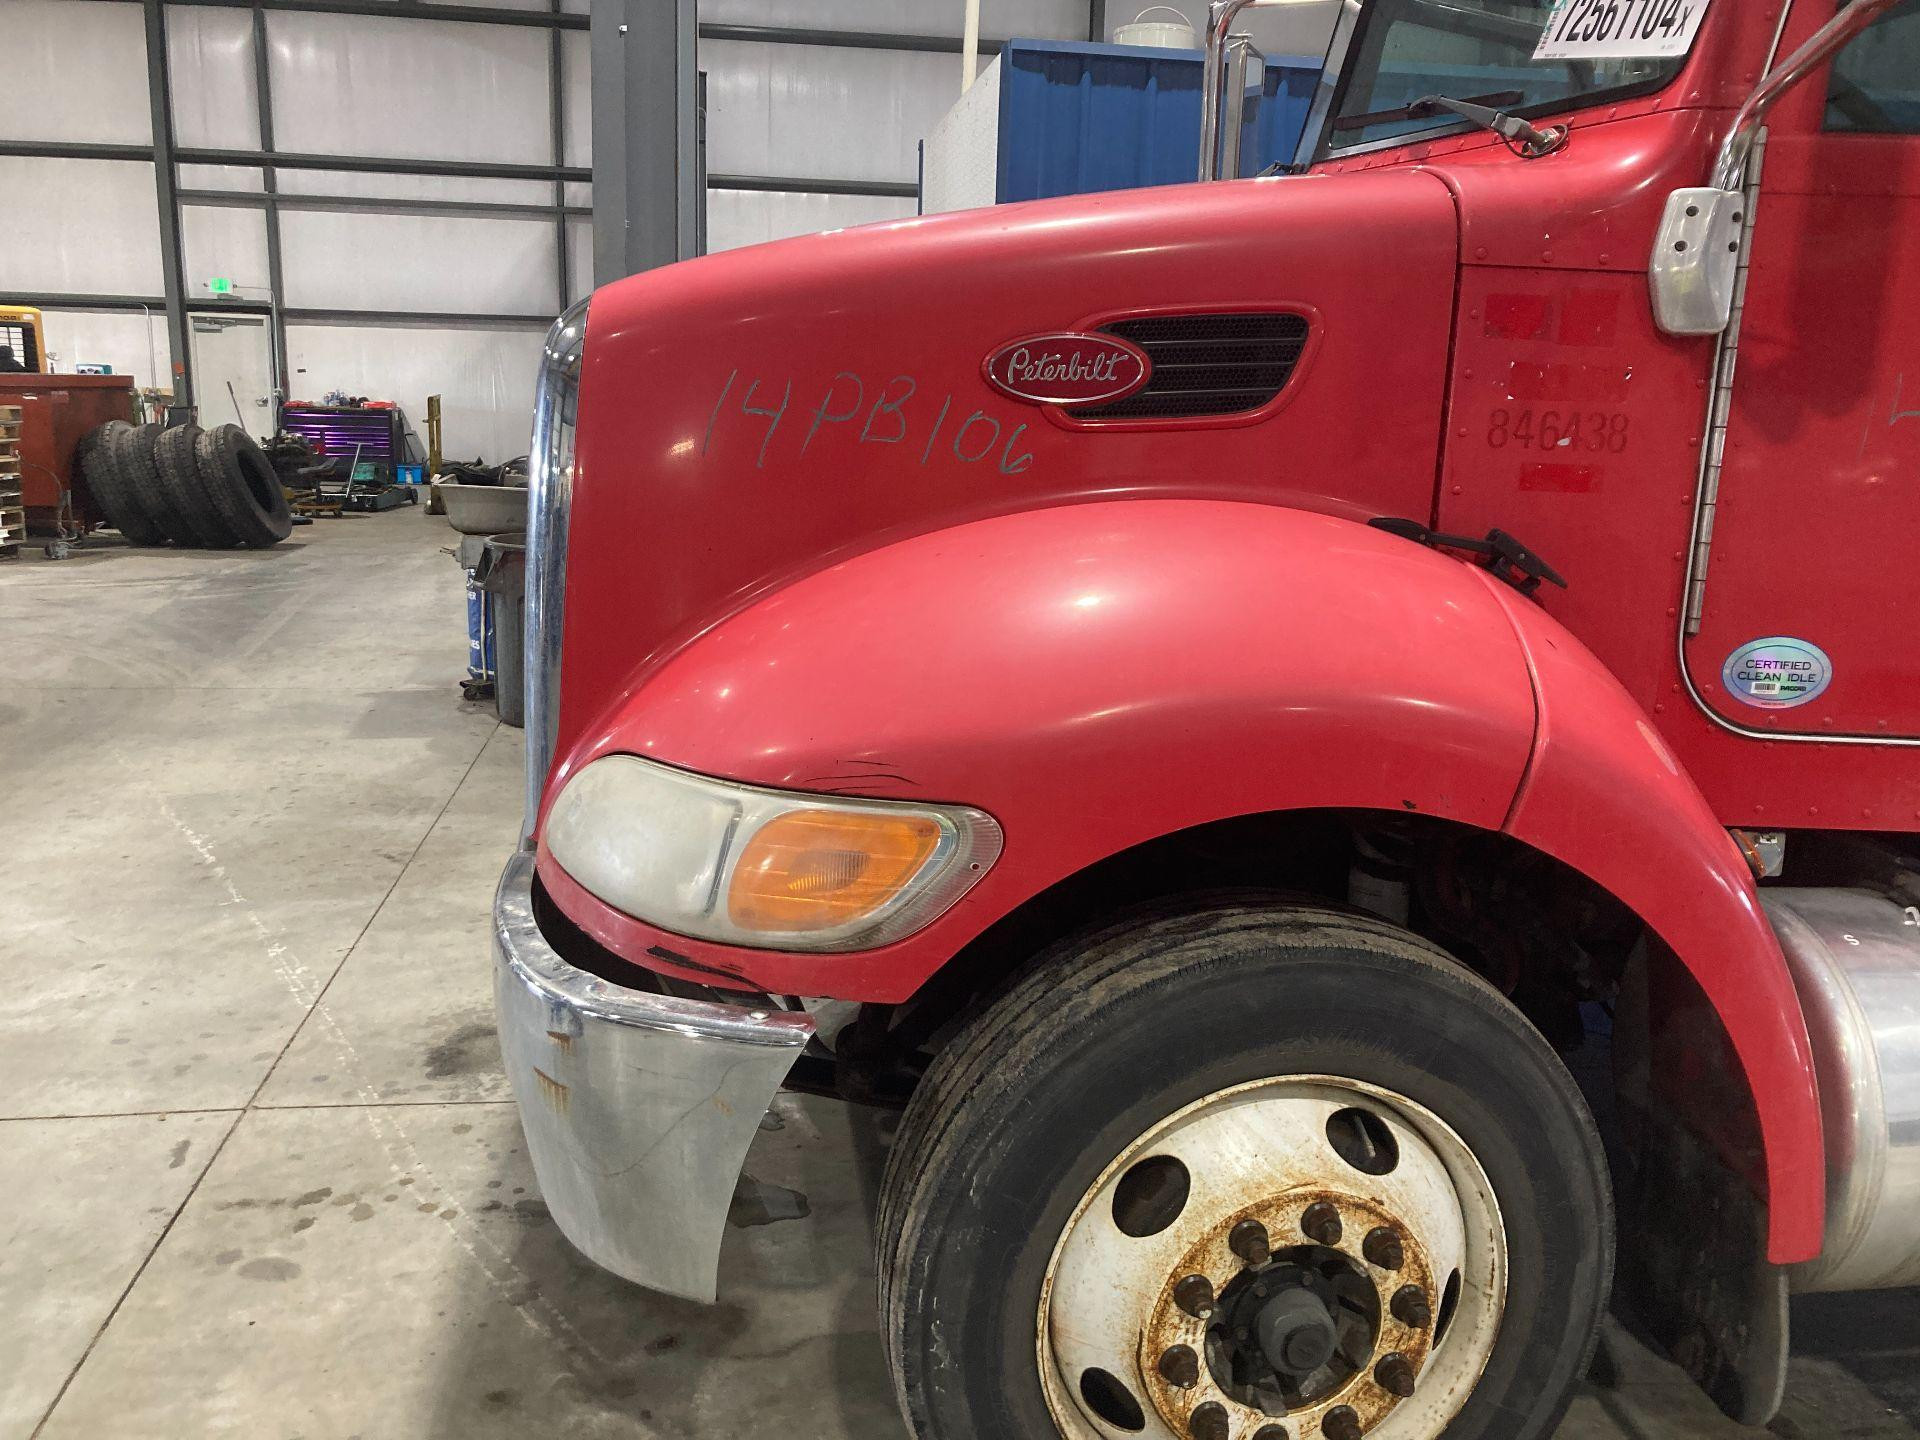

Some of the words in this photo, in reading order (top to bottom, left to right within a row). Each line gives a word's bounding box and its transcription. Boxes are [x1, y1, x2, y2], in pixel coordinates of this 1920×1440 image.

[1007, 347, 1129, 384] Peterbilt
[1746, 659, 1811, 670] CERTIFIED
[1737, 671, 1781, 681] CLEAN
[1788, 673, 1816, 682] IDLE
